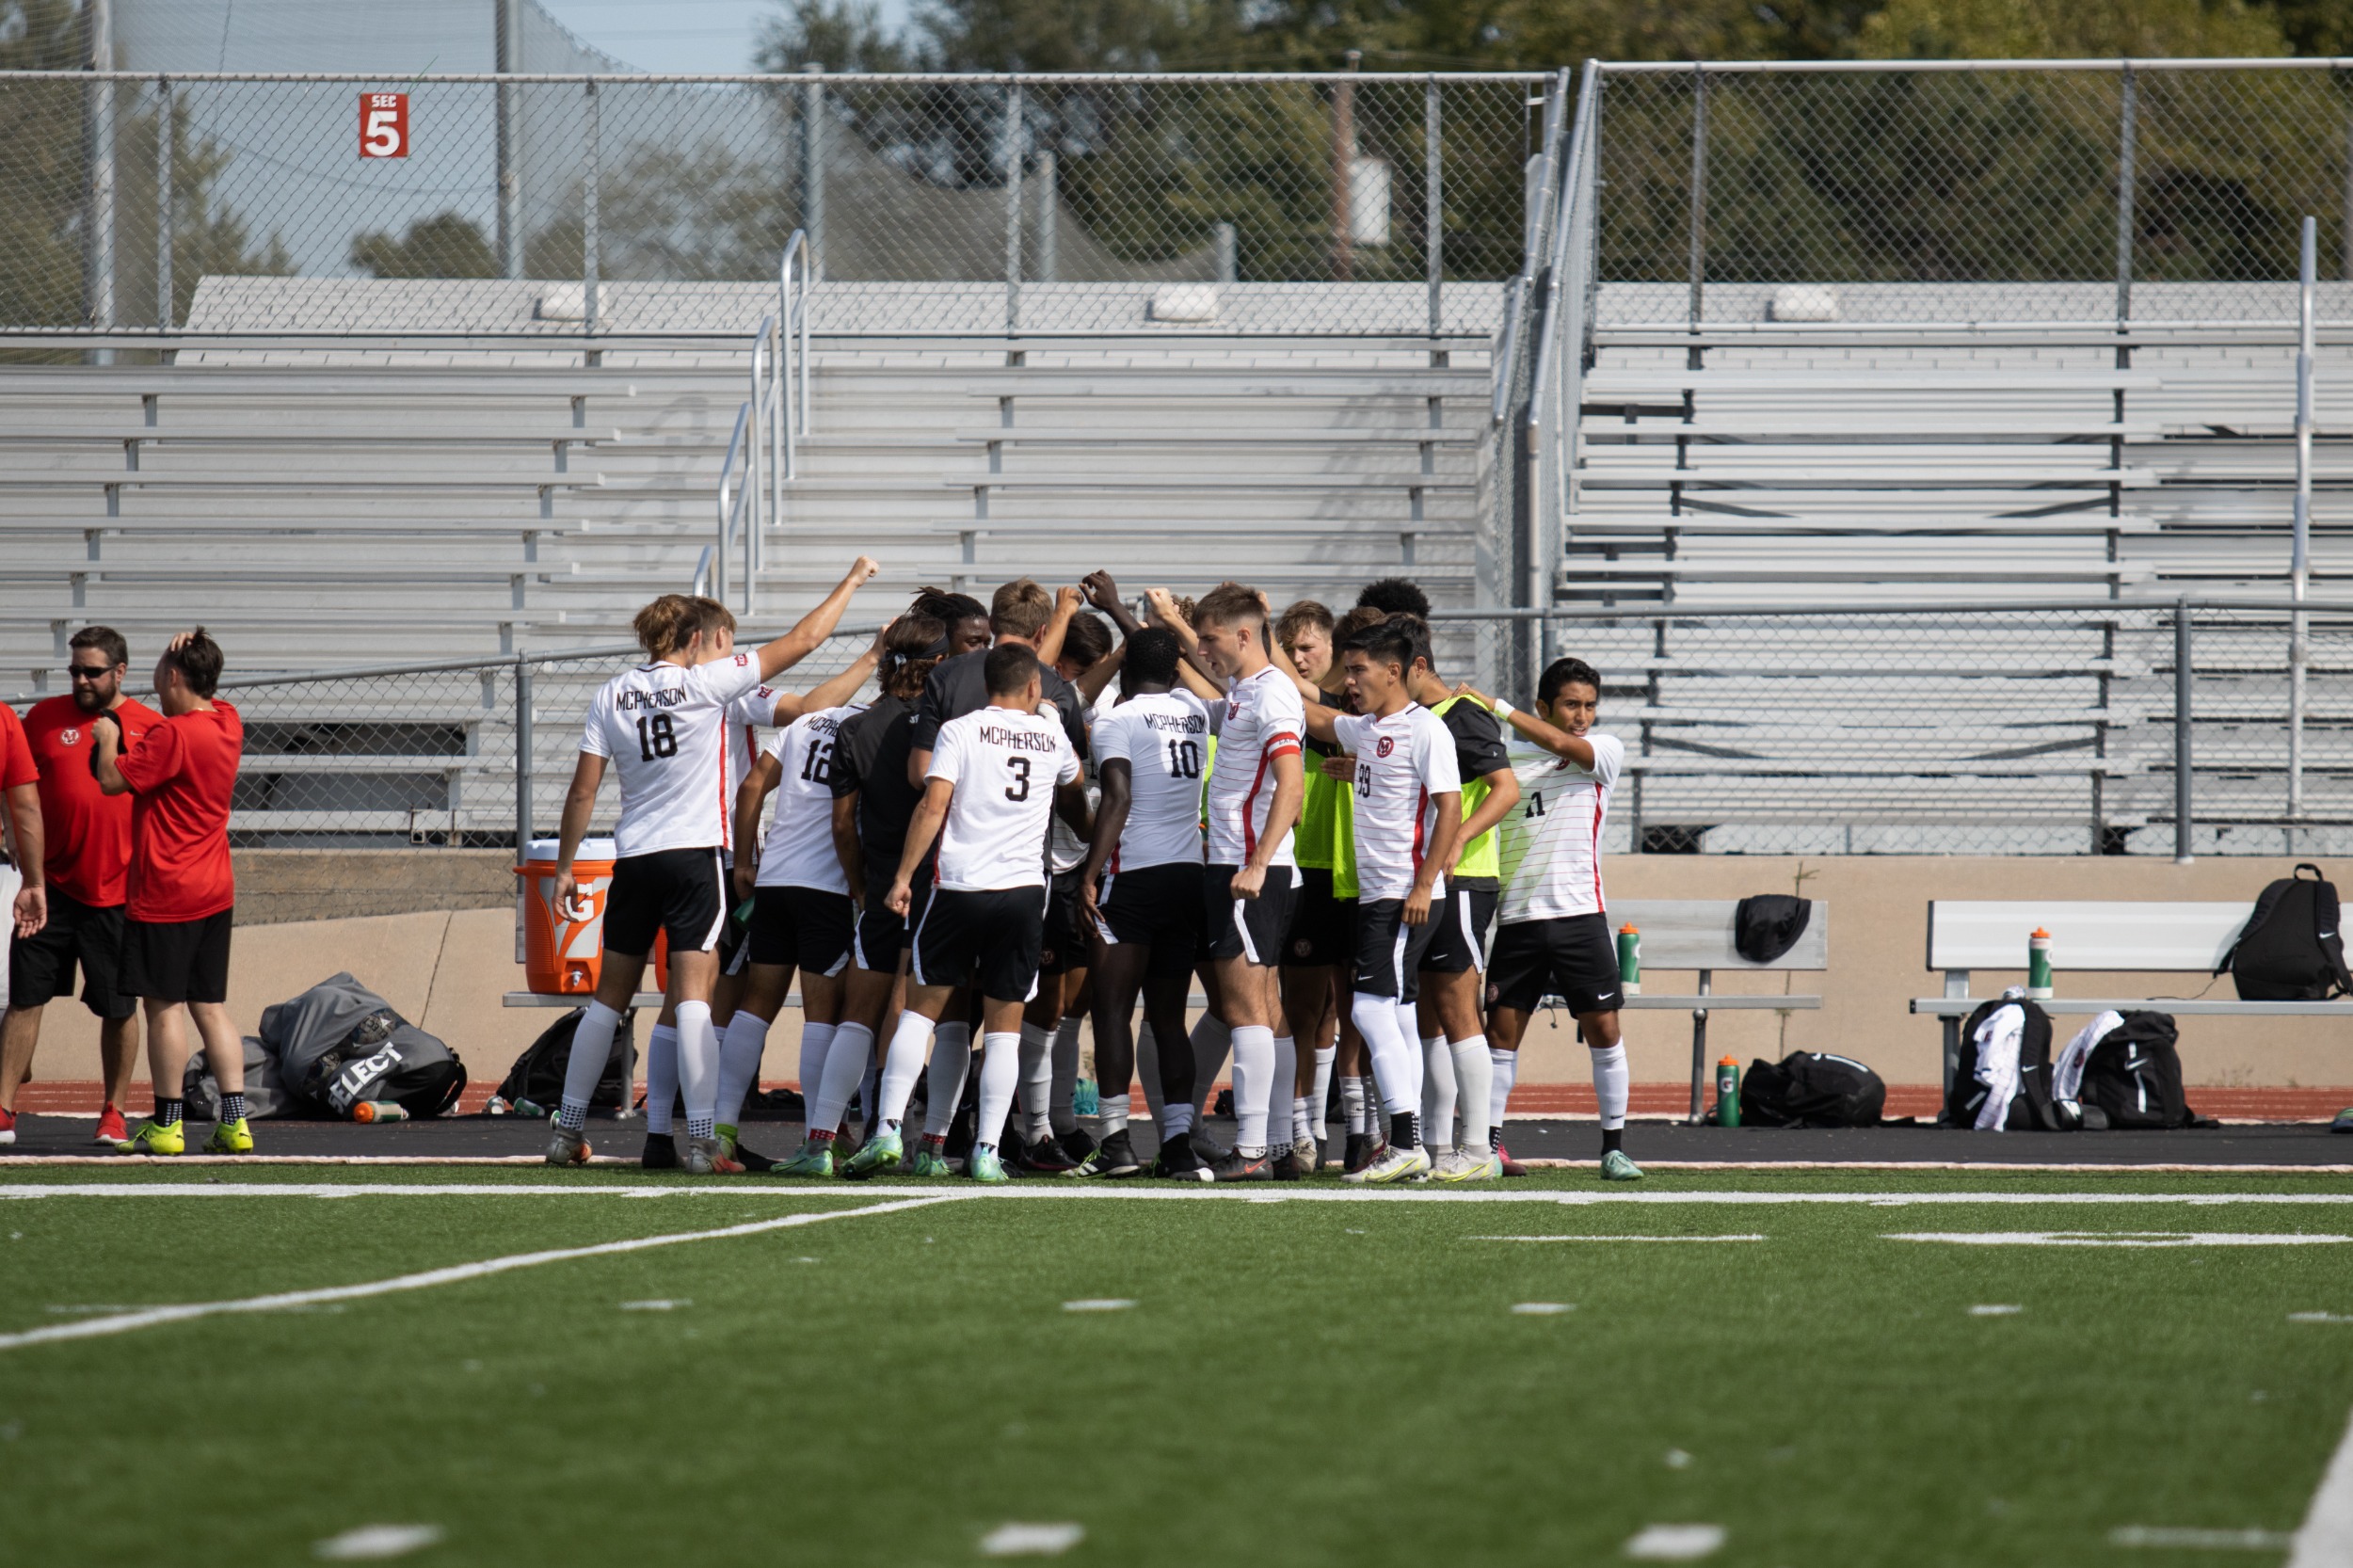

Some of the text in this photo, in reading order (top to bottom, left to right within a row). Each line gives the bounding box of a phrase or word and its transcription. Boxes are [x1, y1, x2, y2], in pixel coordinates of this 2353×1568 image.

[372, 95, 396, 107] SEC
[365, 111, 400, 156] 5
[616, 684, 687, 711] MCPHERSON
[636, 713, 678, 761] 18
[980, 726, 1056, 753] MCPHERSON
[801, 739, 835, 785] 12
[1005, 756, 1031, 802] 3
[1168, 739, 1199, 778] 10
